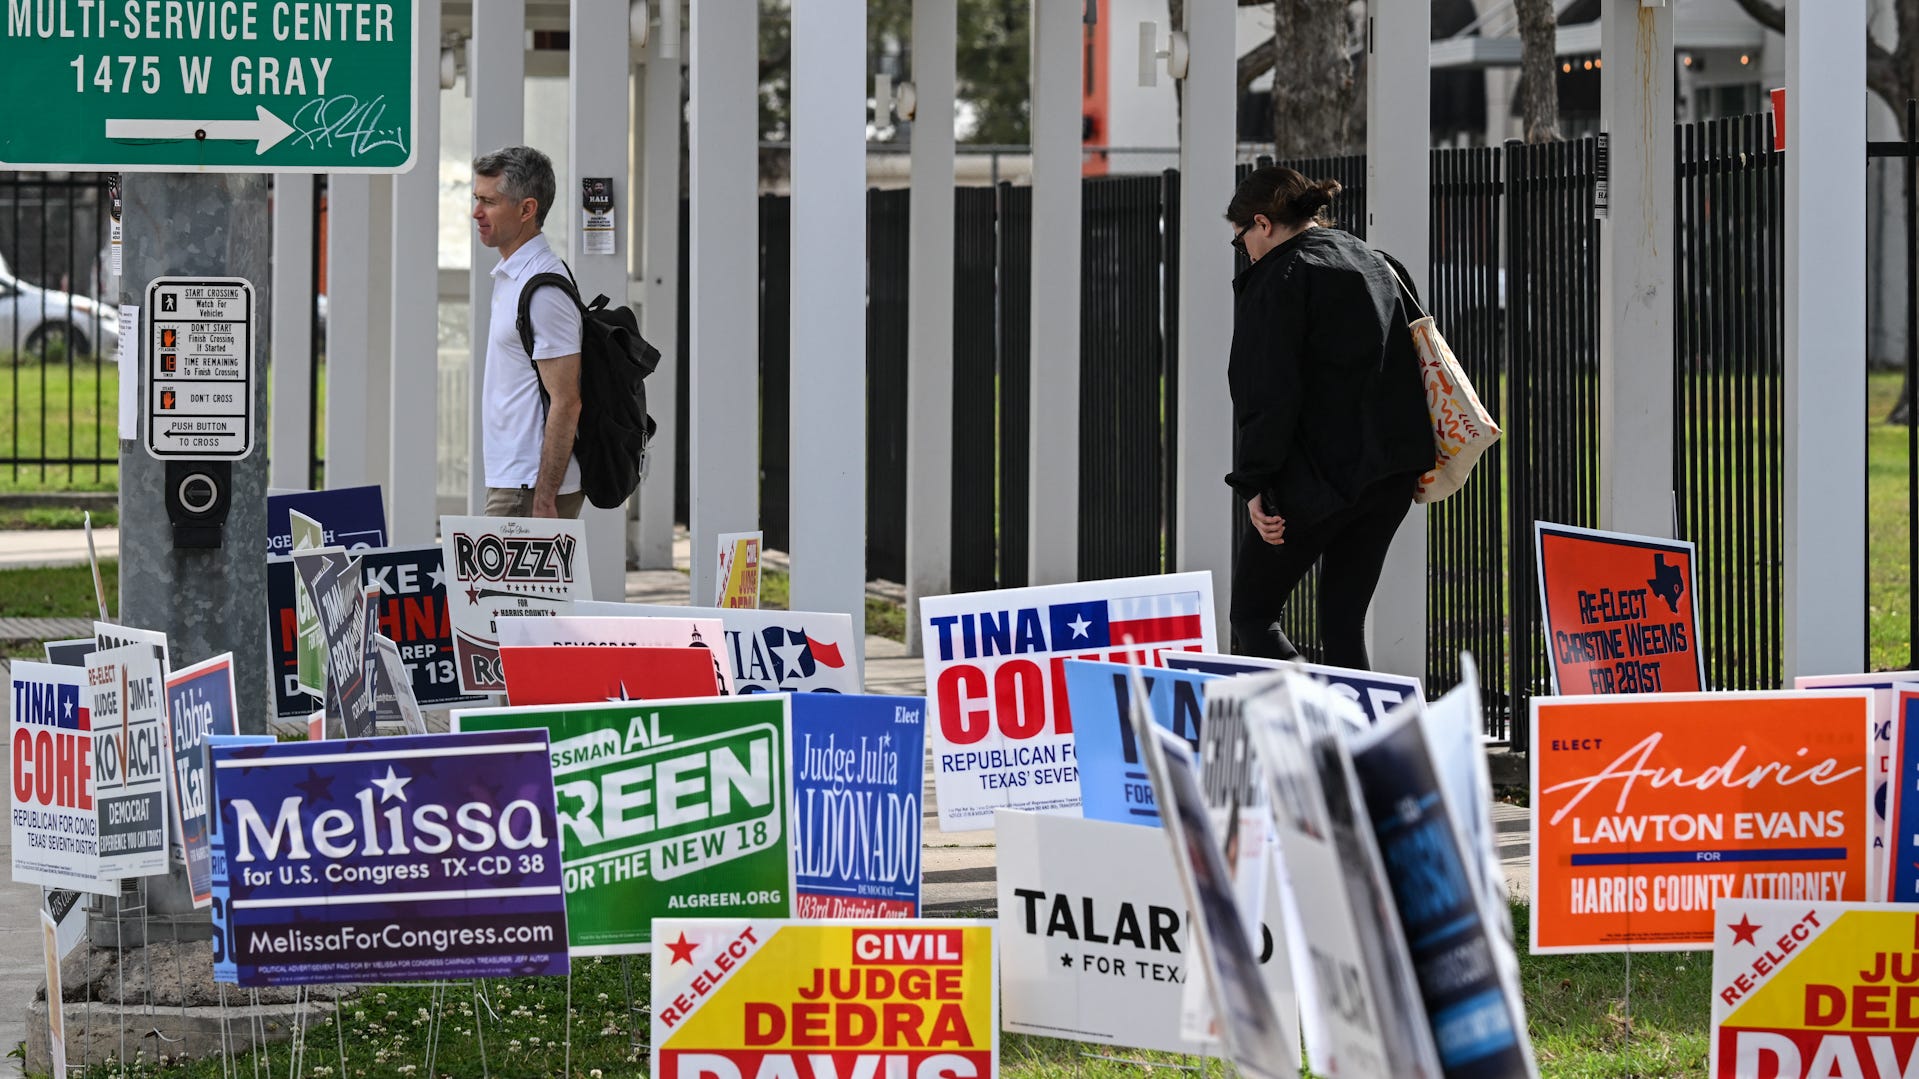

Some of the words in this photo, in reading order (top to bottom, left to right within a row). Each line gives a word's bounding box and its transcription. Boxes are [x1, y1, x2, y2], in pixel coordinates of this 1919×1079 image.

[8, 0, 257, 40] MULTI-SERVICE
[272, 1, 394, 41] CENTER
[70, 55, 160, 94] 1475
[179, 56, 212, 94] W
[230, 56, 333, 96] GRAY
[185, 289, 204, 297] START
[208, 289, 239, 297] CROSSING
[196, 300, 216, 308] Watch
[218, 300, 227, 308] For
[200, 309, 223, 317] Vehicles
[189, 334, 207, 343] Finish
[210, 334, 234, 344] Crossing
[191, 323, 210, 332] DON'T
[213, 323, 232, 332] START
[197, 344, 202, 352] If
[205, 344, 226, 352] Started
[184, 358, 199, 366] TIME
[203, 358, 239, 366] REMAINING
[184, 368, 191, 376] To
[194, 367, 211, 376] Finish
[215, 367, 239, 378] Crossing
[190, 394, 210, 403] DON'T
[213, 394, 233, 403] CROSS
[171, 422, 193, 431] PUSH
[196, 422, 227, 431] BUTTON
[179, 438, 190, 446] TO
[193, 438, 219, 447] CROSS
[453, 532, 576, 582] ROZZY
[517, 599, 528, 607] FOR
[525, 609, 549, 617] COUNTY
[930, 607, 1048, 661] TINA
[1556, 628, 1625, 665] CHRISTINE
[1625, 622, 1688, 658] WEEMS
[401, 644, 437, 660] REP
[88, 664, 116, 686] RE-ELECT
[425, 660, 456, 684] 13
[1589, 667, 1616, 695] FOR
[1616, 660, 1663, 694] 281ST
[14, 680, 56, 727] TINA
[94, 691, 117, 718] JUDGE
[129, 678, 147, 711] JIM
[146, 677, 157, 709] F.
[174, 687, 214, 753] Abbie
[895, 706, 920, 725] Elect
[622, 711, 674, 753] AL
[1552, 738, 1603, 751] ELECT
[14, 728, 95, 811] COHE
[94, 726, 161, 788] KOVACH
[800, 733, 855, 796] Judge
[858, 733, 898, 786] Julia
[942, 747, 1056, 773] REPUBLICAN
[979, 770, 1031, 790] TEXAS'
[1034, 766, 1080, 785] SEVEN
[1543, 731, 1863, 826] Audrie
[555, 736, 771, 852] REEN
[14, 808, 58, 834] REPUBLICAN
[59, 816, 73, 835] FOR
[74, 818, 97, 836] CONG
[108, 798, 150, 825] DEMOCRAT
[230, 768, 549, 863] Melissa
[100, 833, 127, 852] EXPERIENCE
[138, 830, 147, 848] CAN
[147, 829, 161, 847] TRUST
[796, 788, 918, 886] ALDONADO
[1573, 812, 1723, 844] LAWTON
[1735, 810, 1845, 840] EVANS
[28, 832, 48, 849] TEXAS'
[49, 838, 75, 854] SEVENTH
[76, 841, 98, 857] DISTRIC
[564, 865, 594, 893] OR
[600, 851, 648, 884] THE
[662, 829, 726, 870] NEW
[737, 820, 768, 851] 18
[1696, 851, 1722, 862] FOR
[243, 867, 273, 887] for
[279, 864, 319, 885] U.S.
[325, 861, 430, 885] Congress
[441, 855, 512, 878] TX-CD
[518, 854, 545, 874] 38
[668, 890, 781, 909] ALGREEN.ORG
[857, 883, 894, 896] DEMOCRAT
[1571, 874, 1648, 914] HARRIS
[1653, 872, 1736, 912] COUNTY
[1742, 871, 1847, 901] ATTORNEY
[832, 897, 875, 919] District
[877, 900, 908, 919] Court
[248, 923, 554, 955] MelissaForCongress.com
[856, 933, 960, 961] CIVIL
[1083, 955, 1126, 977] FOR
[1719, 909, 1821, 1007] RE-ELECT
[659, 925, 758, 1028] RE-ELECT
[797, 968, 963, 1000] JUDGE
[744, 1002, 975, 1048] DEDRA
